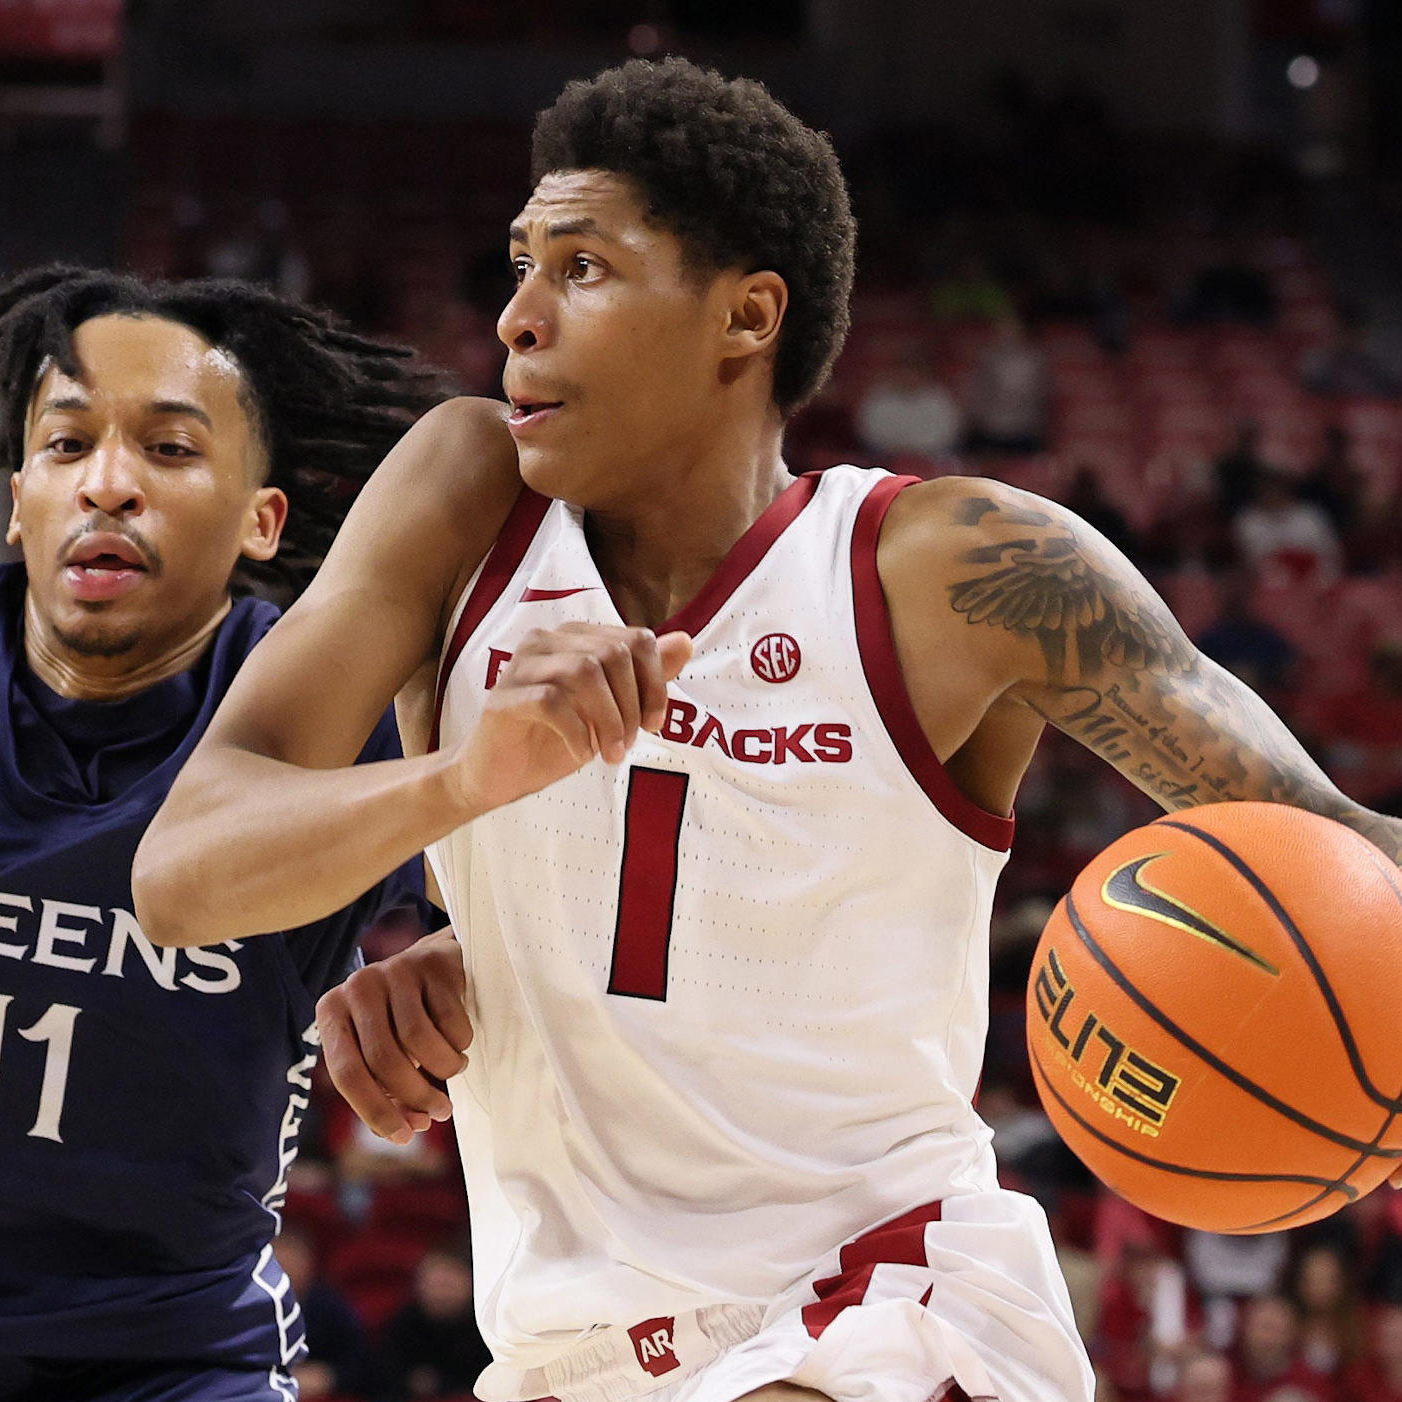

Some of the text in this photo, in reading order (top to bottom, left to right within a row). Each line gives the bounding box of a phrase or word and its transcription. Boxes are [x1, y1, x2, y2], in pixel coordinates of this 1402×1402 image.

[754, 635, 797, 680] SEC
[607, 765, 689, 1002] 1
[1035, 946, 1182, 1127] ELITE
[639, 1328, 675, 1364] AR
